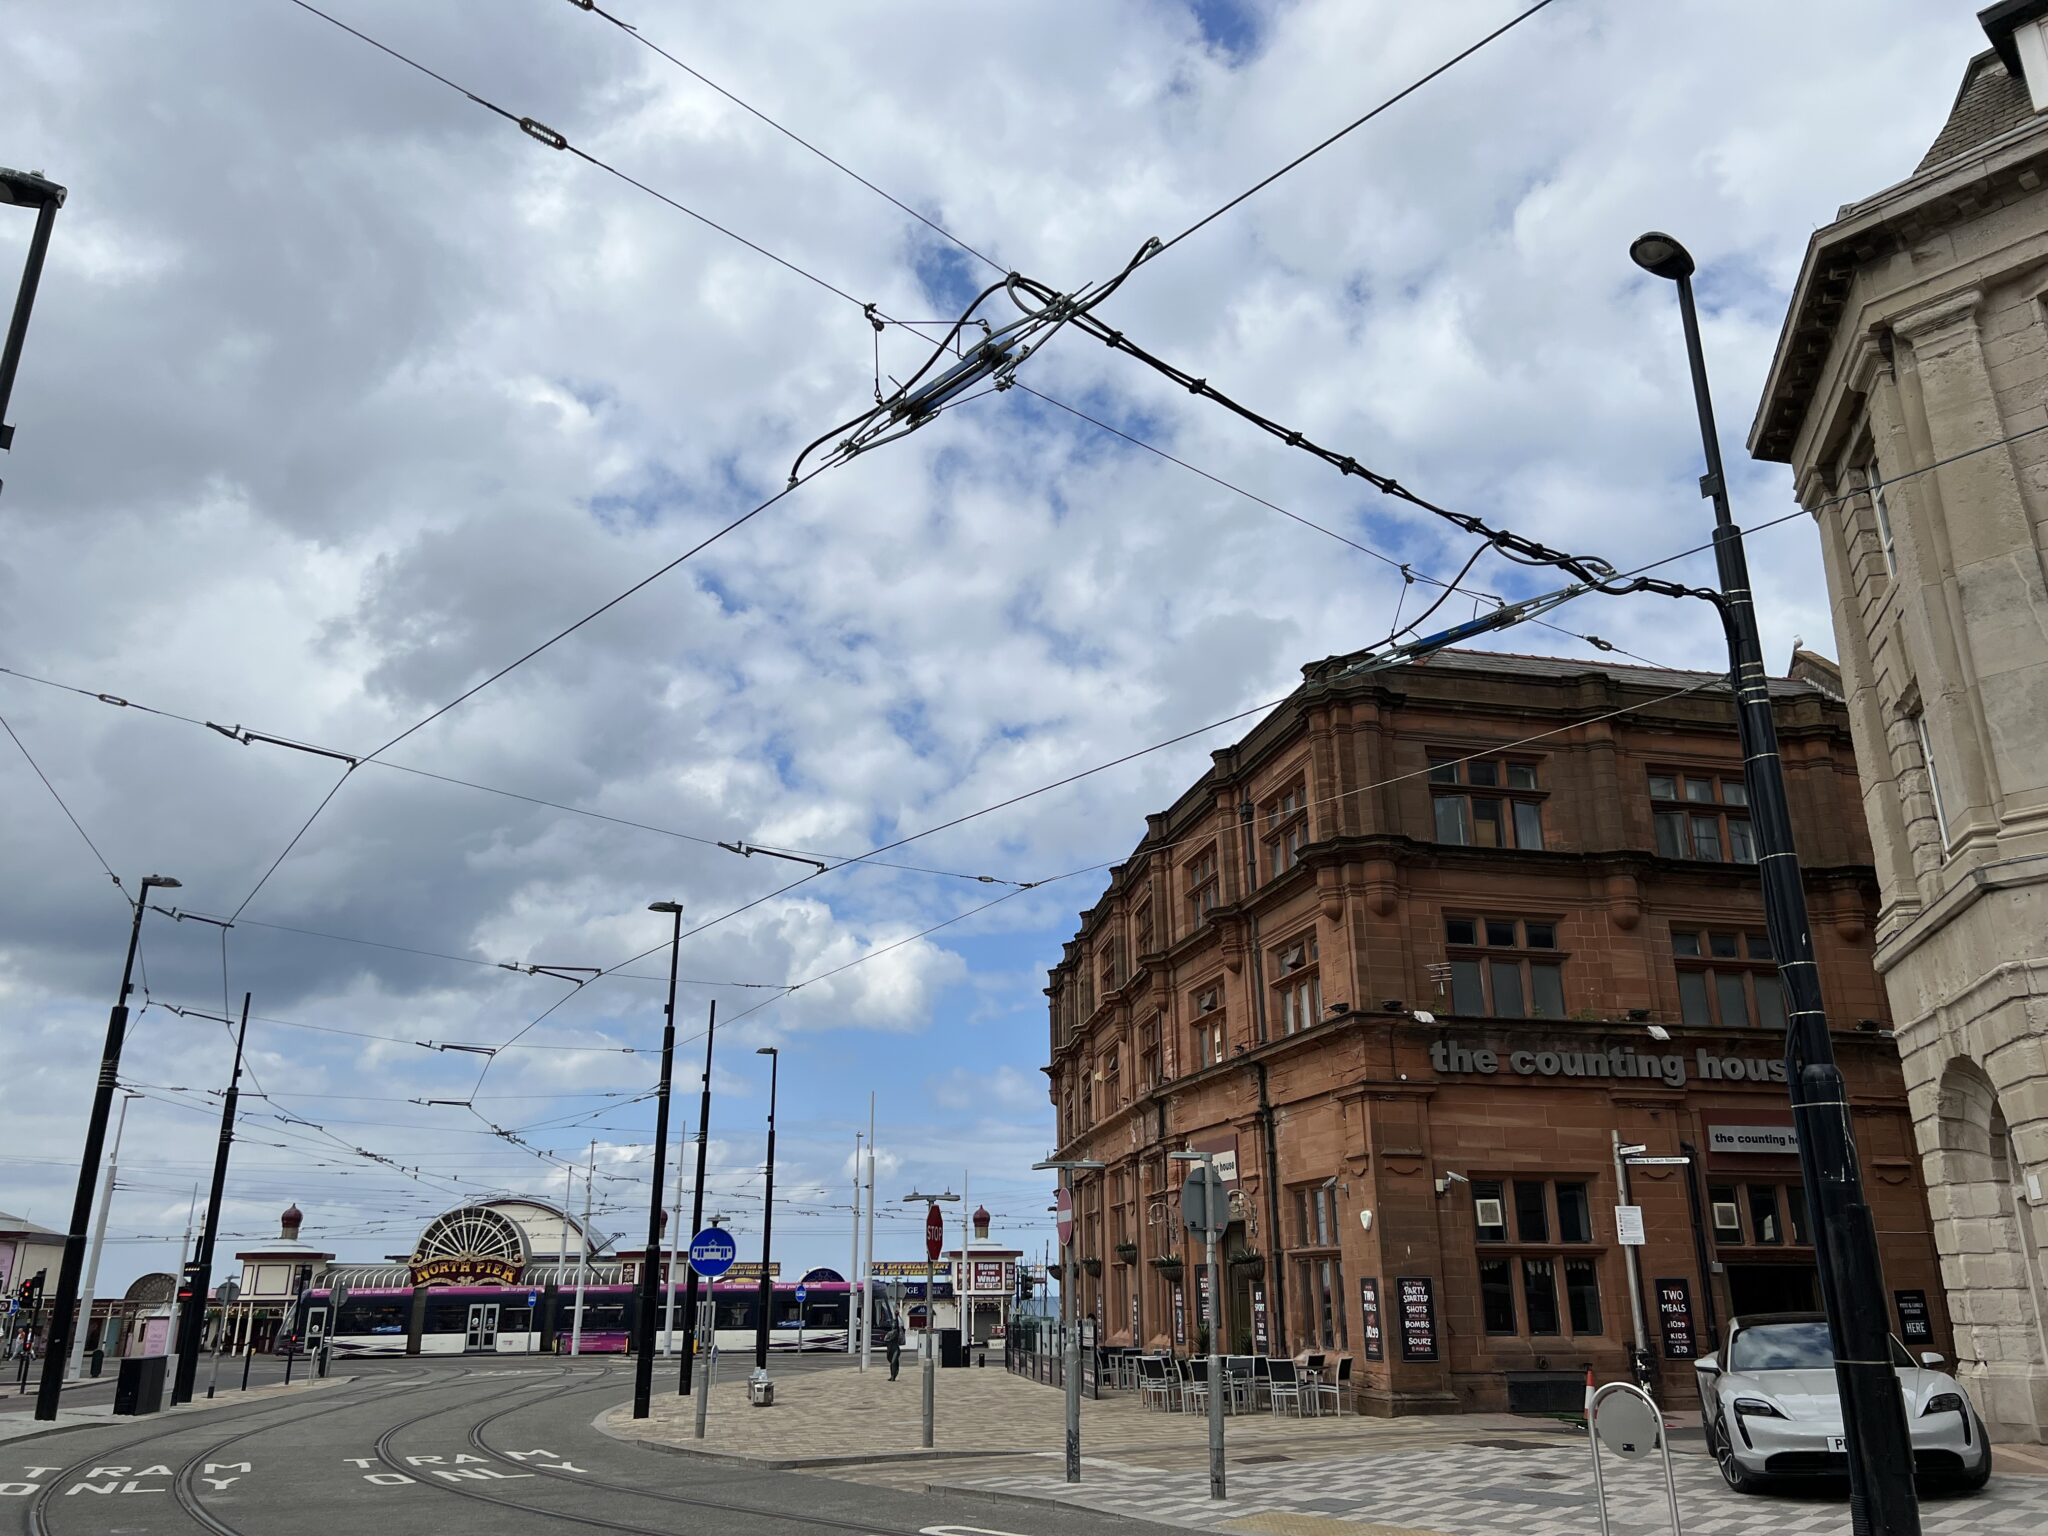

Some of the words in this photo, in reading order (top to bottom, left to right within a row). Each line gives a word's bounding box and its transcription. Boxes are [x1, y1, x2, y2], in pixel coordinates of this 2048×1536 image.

[1429, 1040, 1498, 1074] the
[1509, 1046, 1687, 1087] counting
[1696, 1048, 1788, 1082] hous
[1714, 1133, 1734, 1143] the
[1737, 1134, 1785, 1146] counting
[1220, 1161, 1234, 1172] house
[927, 1225, 942, 1242] STOP
[415, 1261, 471, 1283] NORTH
[476, 1261, 517, 1283] PIER
[1363, 1290, 1375, 1302] TWO
[1404, 1286, 1426, 1295] PARTY
[1662, 1290, 1684, 1300] TWO
[1403, 1294, 1428, 1303] STARTED
[1364, 1304, 1376, 1312] MEALS
[1406, 1306, 1428, 1314] SHOTS
[1662, 1304, 1686, 1312] MEALS
[1405, 1320, 1430, 1328] BOMBS
[1906, 1322, 1926, 1333] HERE
[1408, 1338, 1432, 1346] SOURZ
[343, 1449, 560, 1468] TRAM
[24, 1462, 251, 1478] TRAM
[363, 1462, 588, 1485] ONLY
[0, 1477, 241, 1495] ONLY
